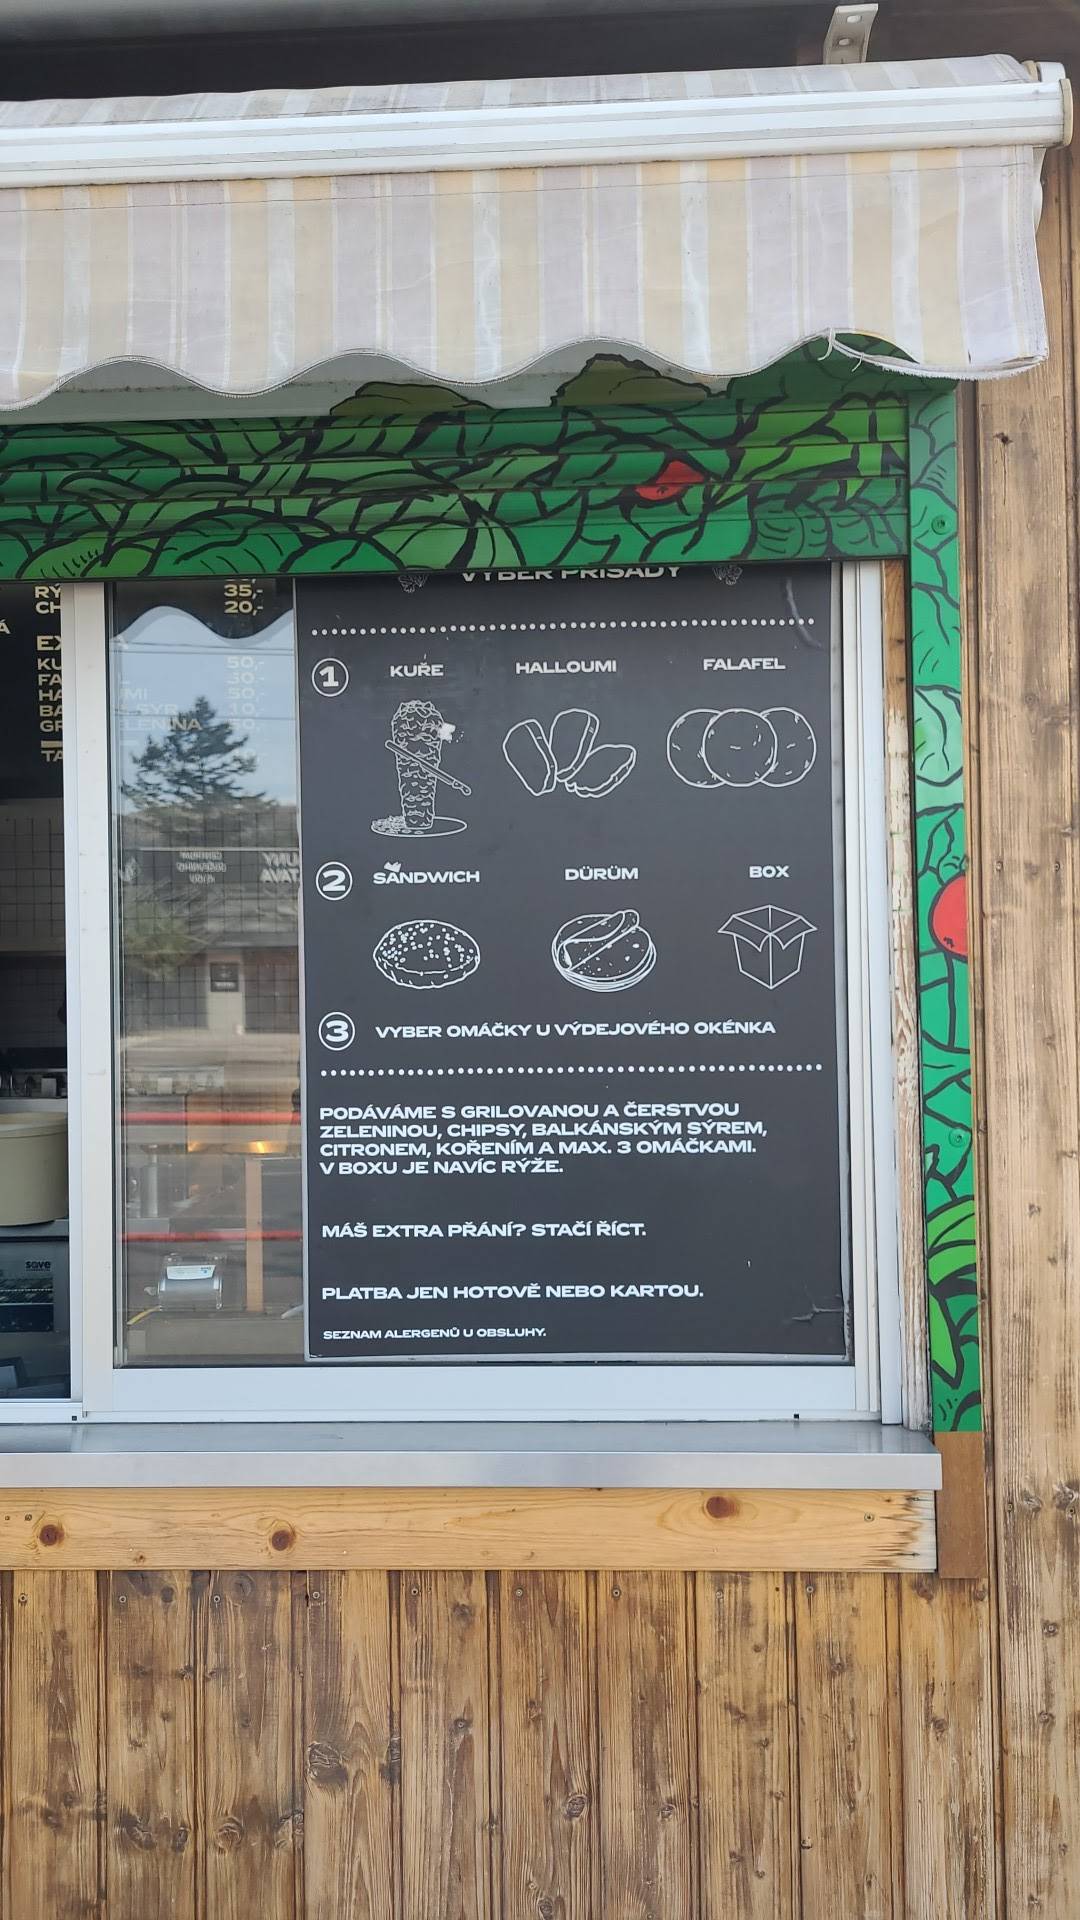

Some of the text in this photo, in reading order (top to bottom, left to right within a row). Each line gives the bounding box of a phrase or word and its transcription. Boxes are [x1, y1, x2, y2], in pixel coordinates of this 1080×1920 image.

[224, 584, 263, 598] 35,-
[224, 601, 264, 616] 20,-
[390, 662, 444, 678] KUŘE
[515, 659, 617, 675] HALLOUMI
[703, 657, 786, 671] FALAFEL
[373, 871, 480, 884] SANDWICH
[564, 865, 639, 881] DÜRÜM
[749, 865, 790, 879] BOX
[375, 1018, 776, 1039] VYBER OMÁČKY U VÝDEJOVÉHO OKÉNKA
[319, 1101, 740, 1121] PODÁVÁME S GRILOVANOU A ČERSTVOU
[319, 1118, 768, 1141] ZELENINOU, CHIPSY, BALKÁNSKÝM SÝREM,
[319, 1137, 757, 1159] CITRONEM, KOŘENÍM A MAX. 3 OMÁČKAMI.
[319, 1157, 564, 1175] V BOXU JE NAVÍC RÝŽE.
[322, 1220, 647, 1238] MÁŠ EXTRA PŘÁNÍ? STAČÍ ŘÍCT.
[322, 1282, 704, 1300] PLATBA JEN HOTOVĚ NEBO KARTOU.
[323, 1326, 547, 1340] SEZNAM ALERGENŮ U OBSLUHY.
